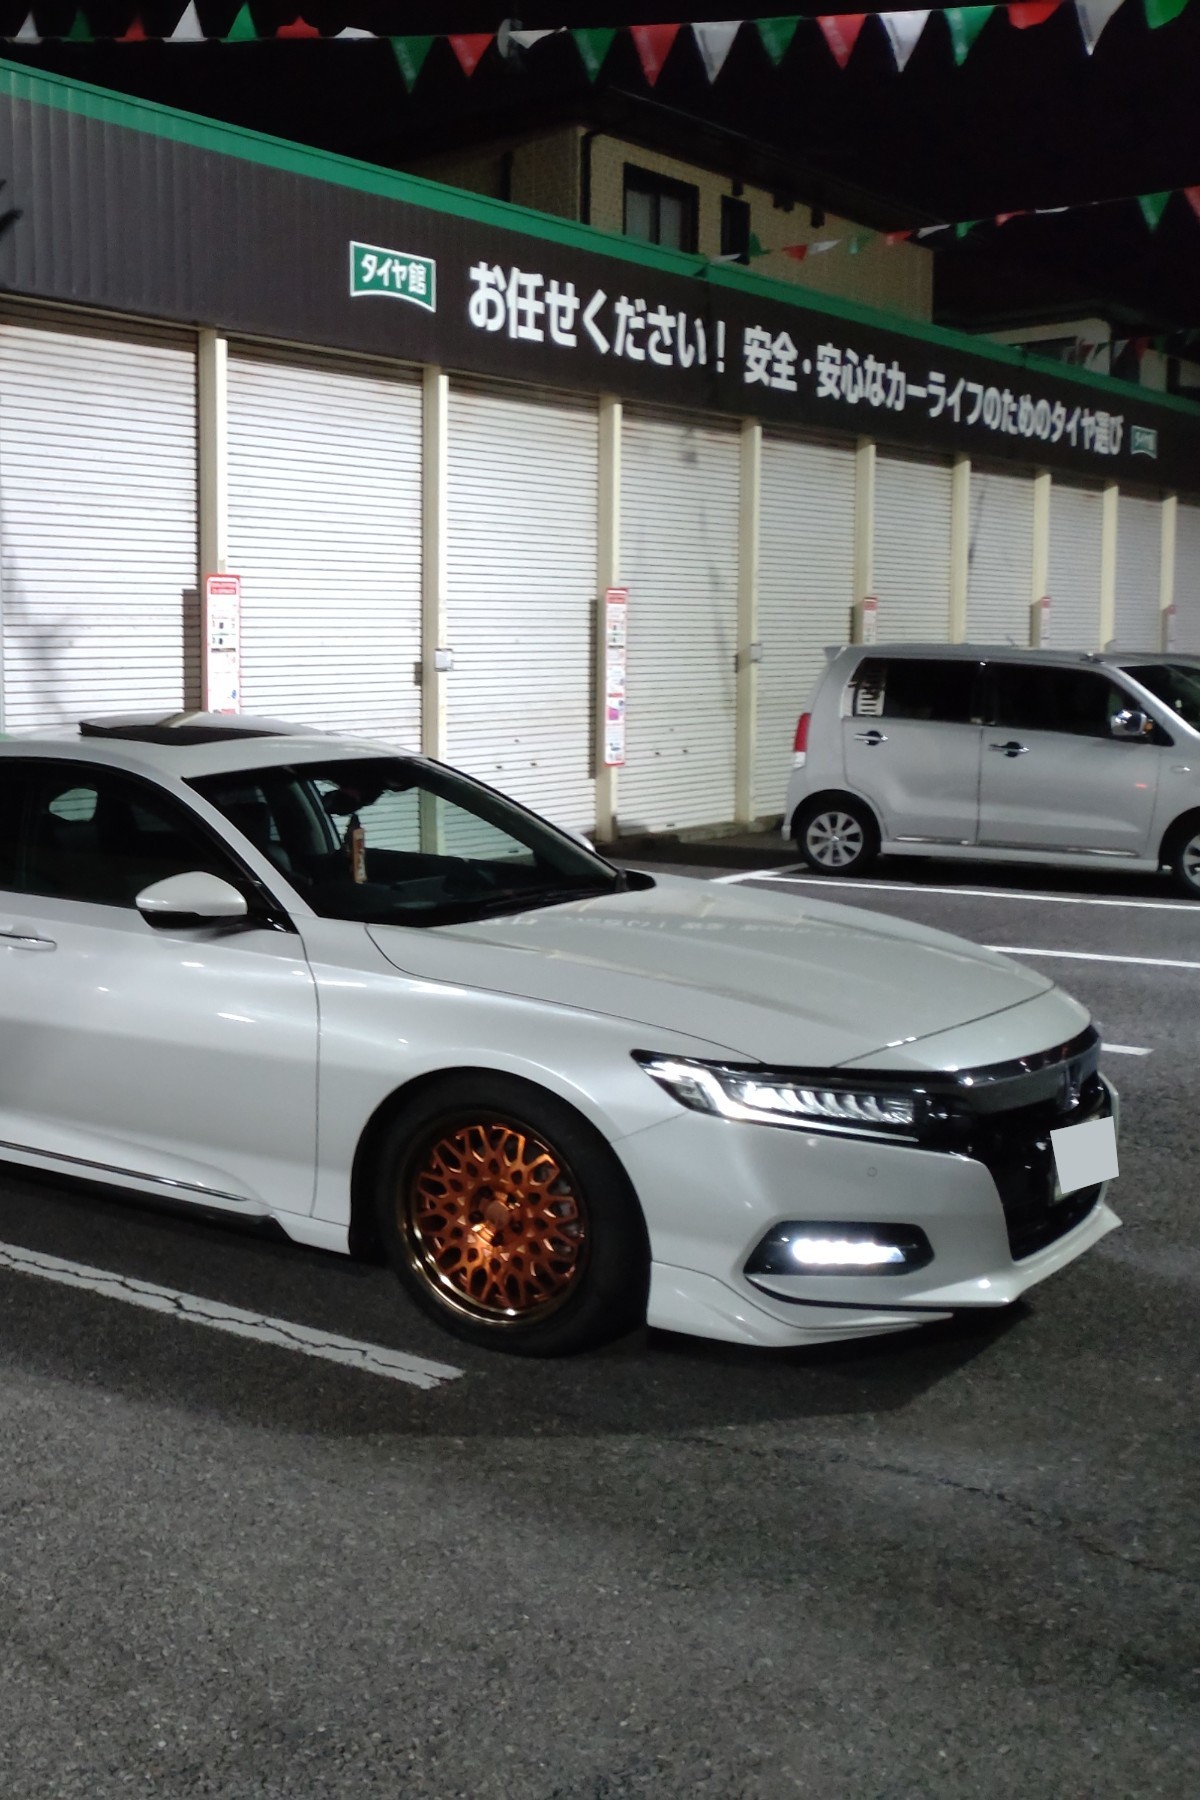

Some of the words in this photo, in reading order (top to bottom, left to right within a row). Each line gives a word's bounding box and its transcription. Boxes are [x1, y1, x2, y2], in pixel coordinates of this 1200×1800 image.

[361, 253, 427, 296] タイヤ館
[743, 325, 1124, 456] 安全・安心なカーライフのためのタイヤ選び
